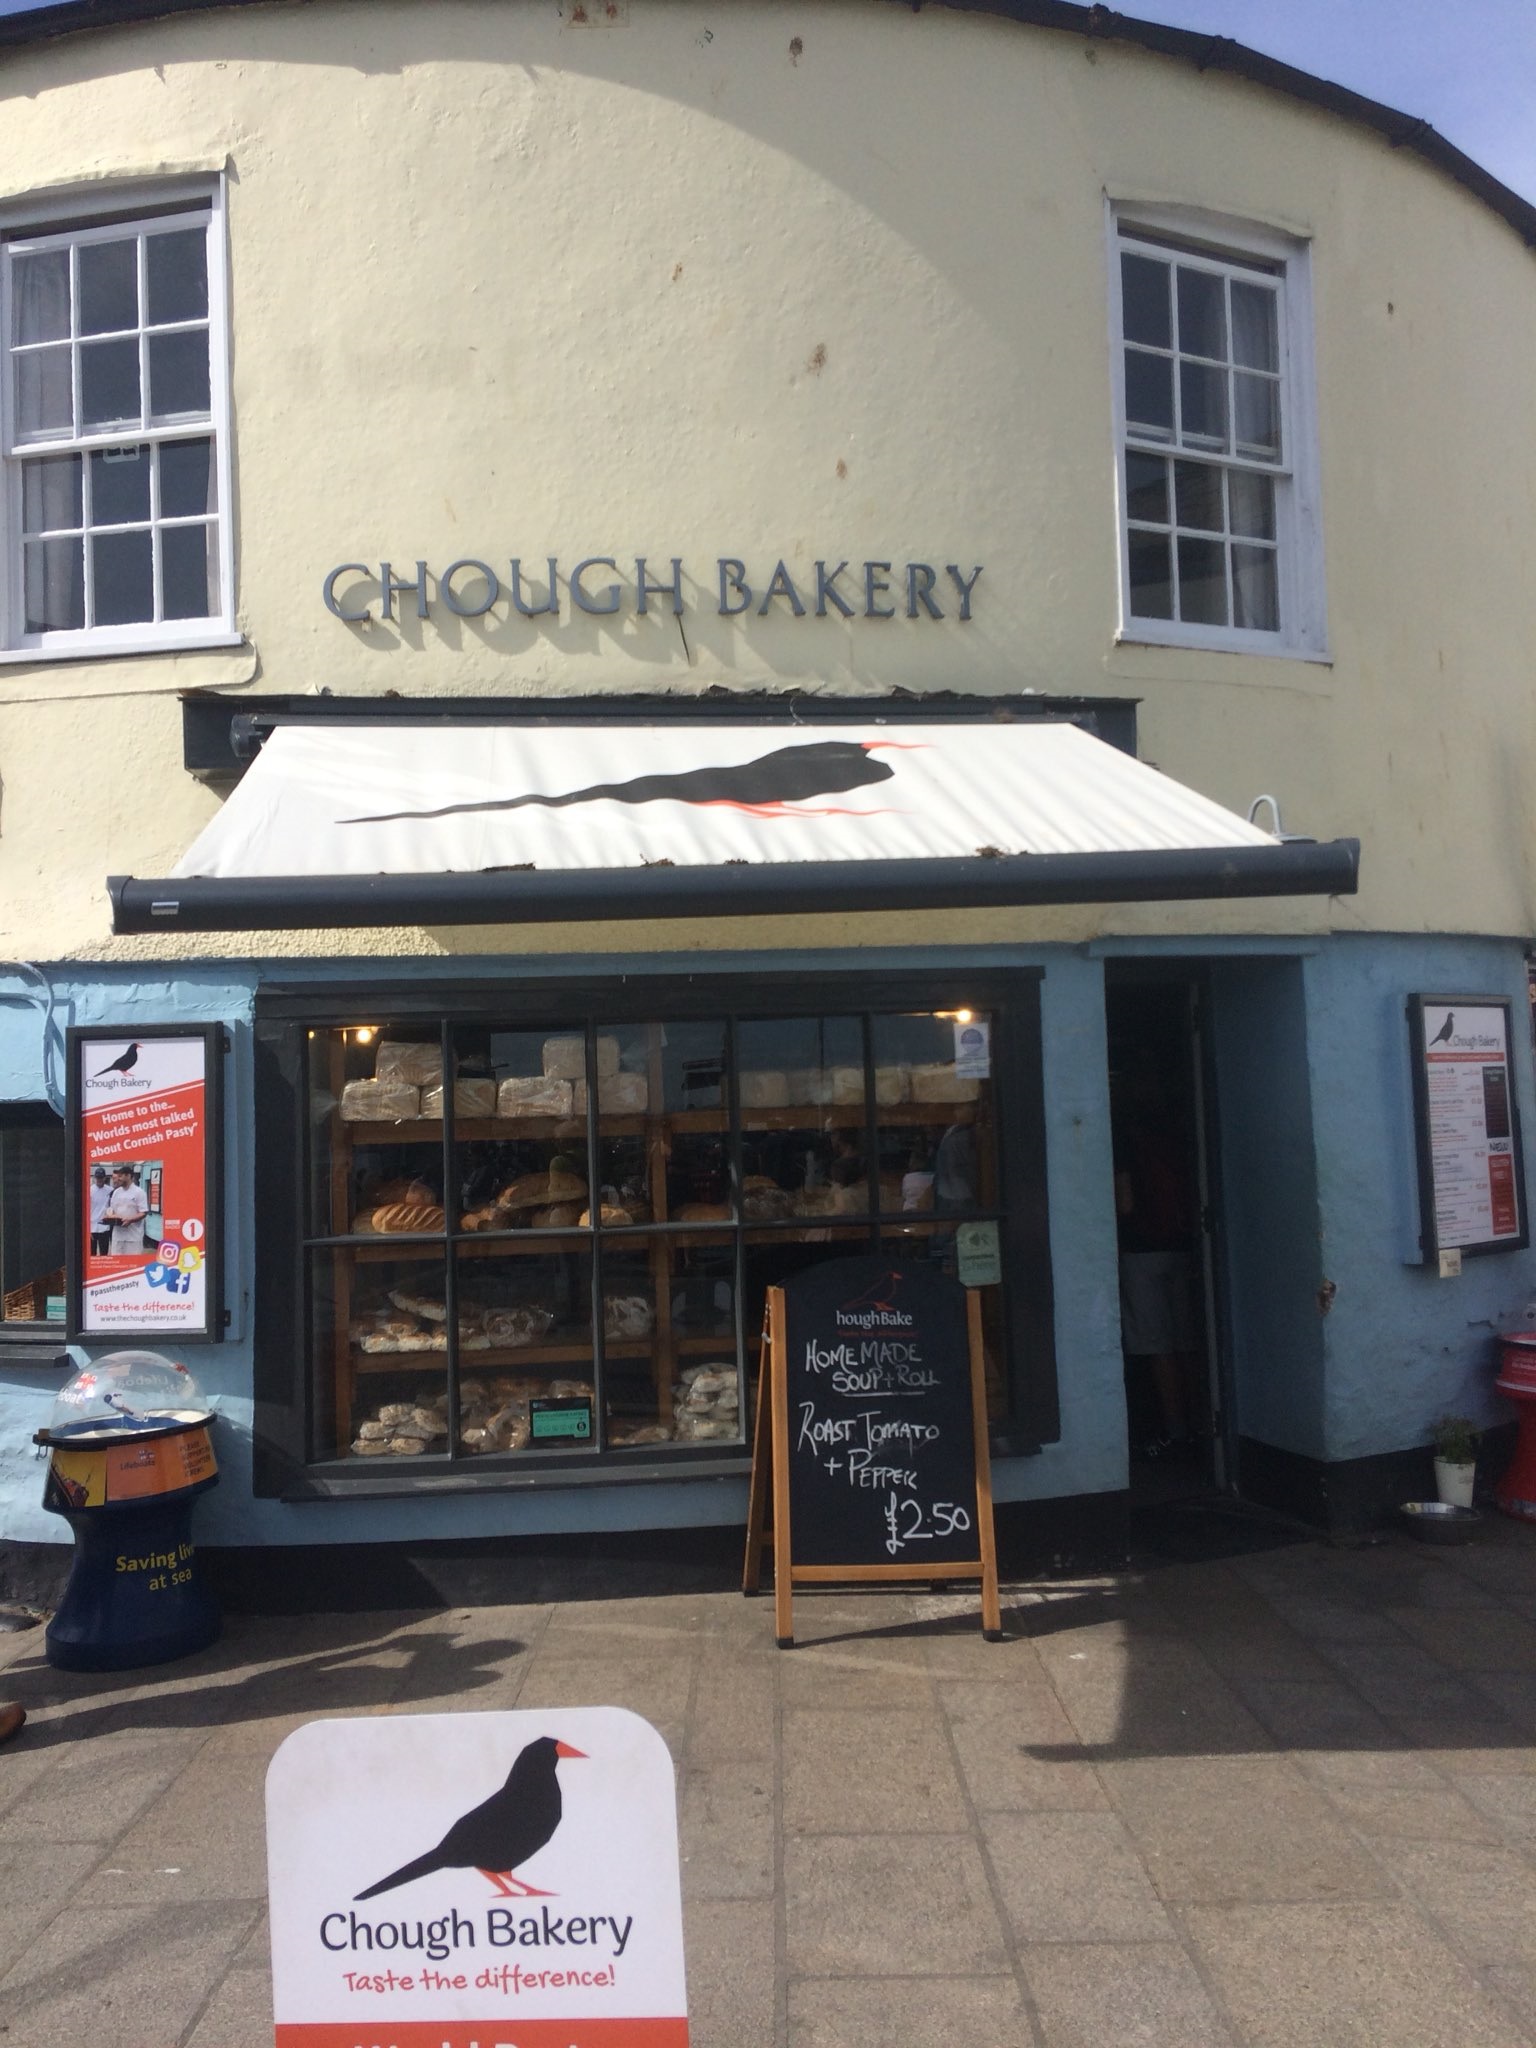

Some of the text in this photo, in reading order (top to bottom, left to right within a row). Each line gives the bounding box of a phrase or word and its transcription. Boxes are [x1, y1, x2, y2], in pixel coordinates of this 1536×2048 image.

[323, 557, 983, 622] CHOUGH BAKERY
[85, 1078, 152, 1090] Chough Bakery
[102, 1108, 134, 1125] Home
[137, 1106, 148, 1116] to
[132, 1117, 158, 1133] most
[160, 1108, 195, 1125] talked
[90, 1143, 121, 1158] about
[123, 1132, 164, 1150] Cornish
[90, 1280, 140, 1297] #passthepasty
[93, 1301, 195, 1313] Taste the difference!
[797, 1401, 940, 1456] ROAST TOMATO
[847, 1448, 918, 1490] PEPPER
[884, 1491, 970, 1555] £2.50
[115, 1552, 177, 1572] Saving
[149, 1568, 192, 1591] at sea
[319, 1906, 634, 1961] Chough Bakery
[342, 1964, 617, 1996] Taste the difference!
